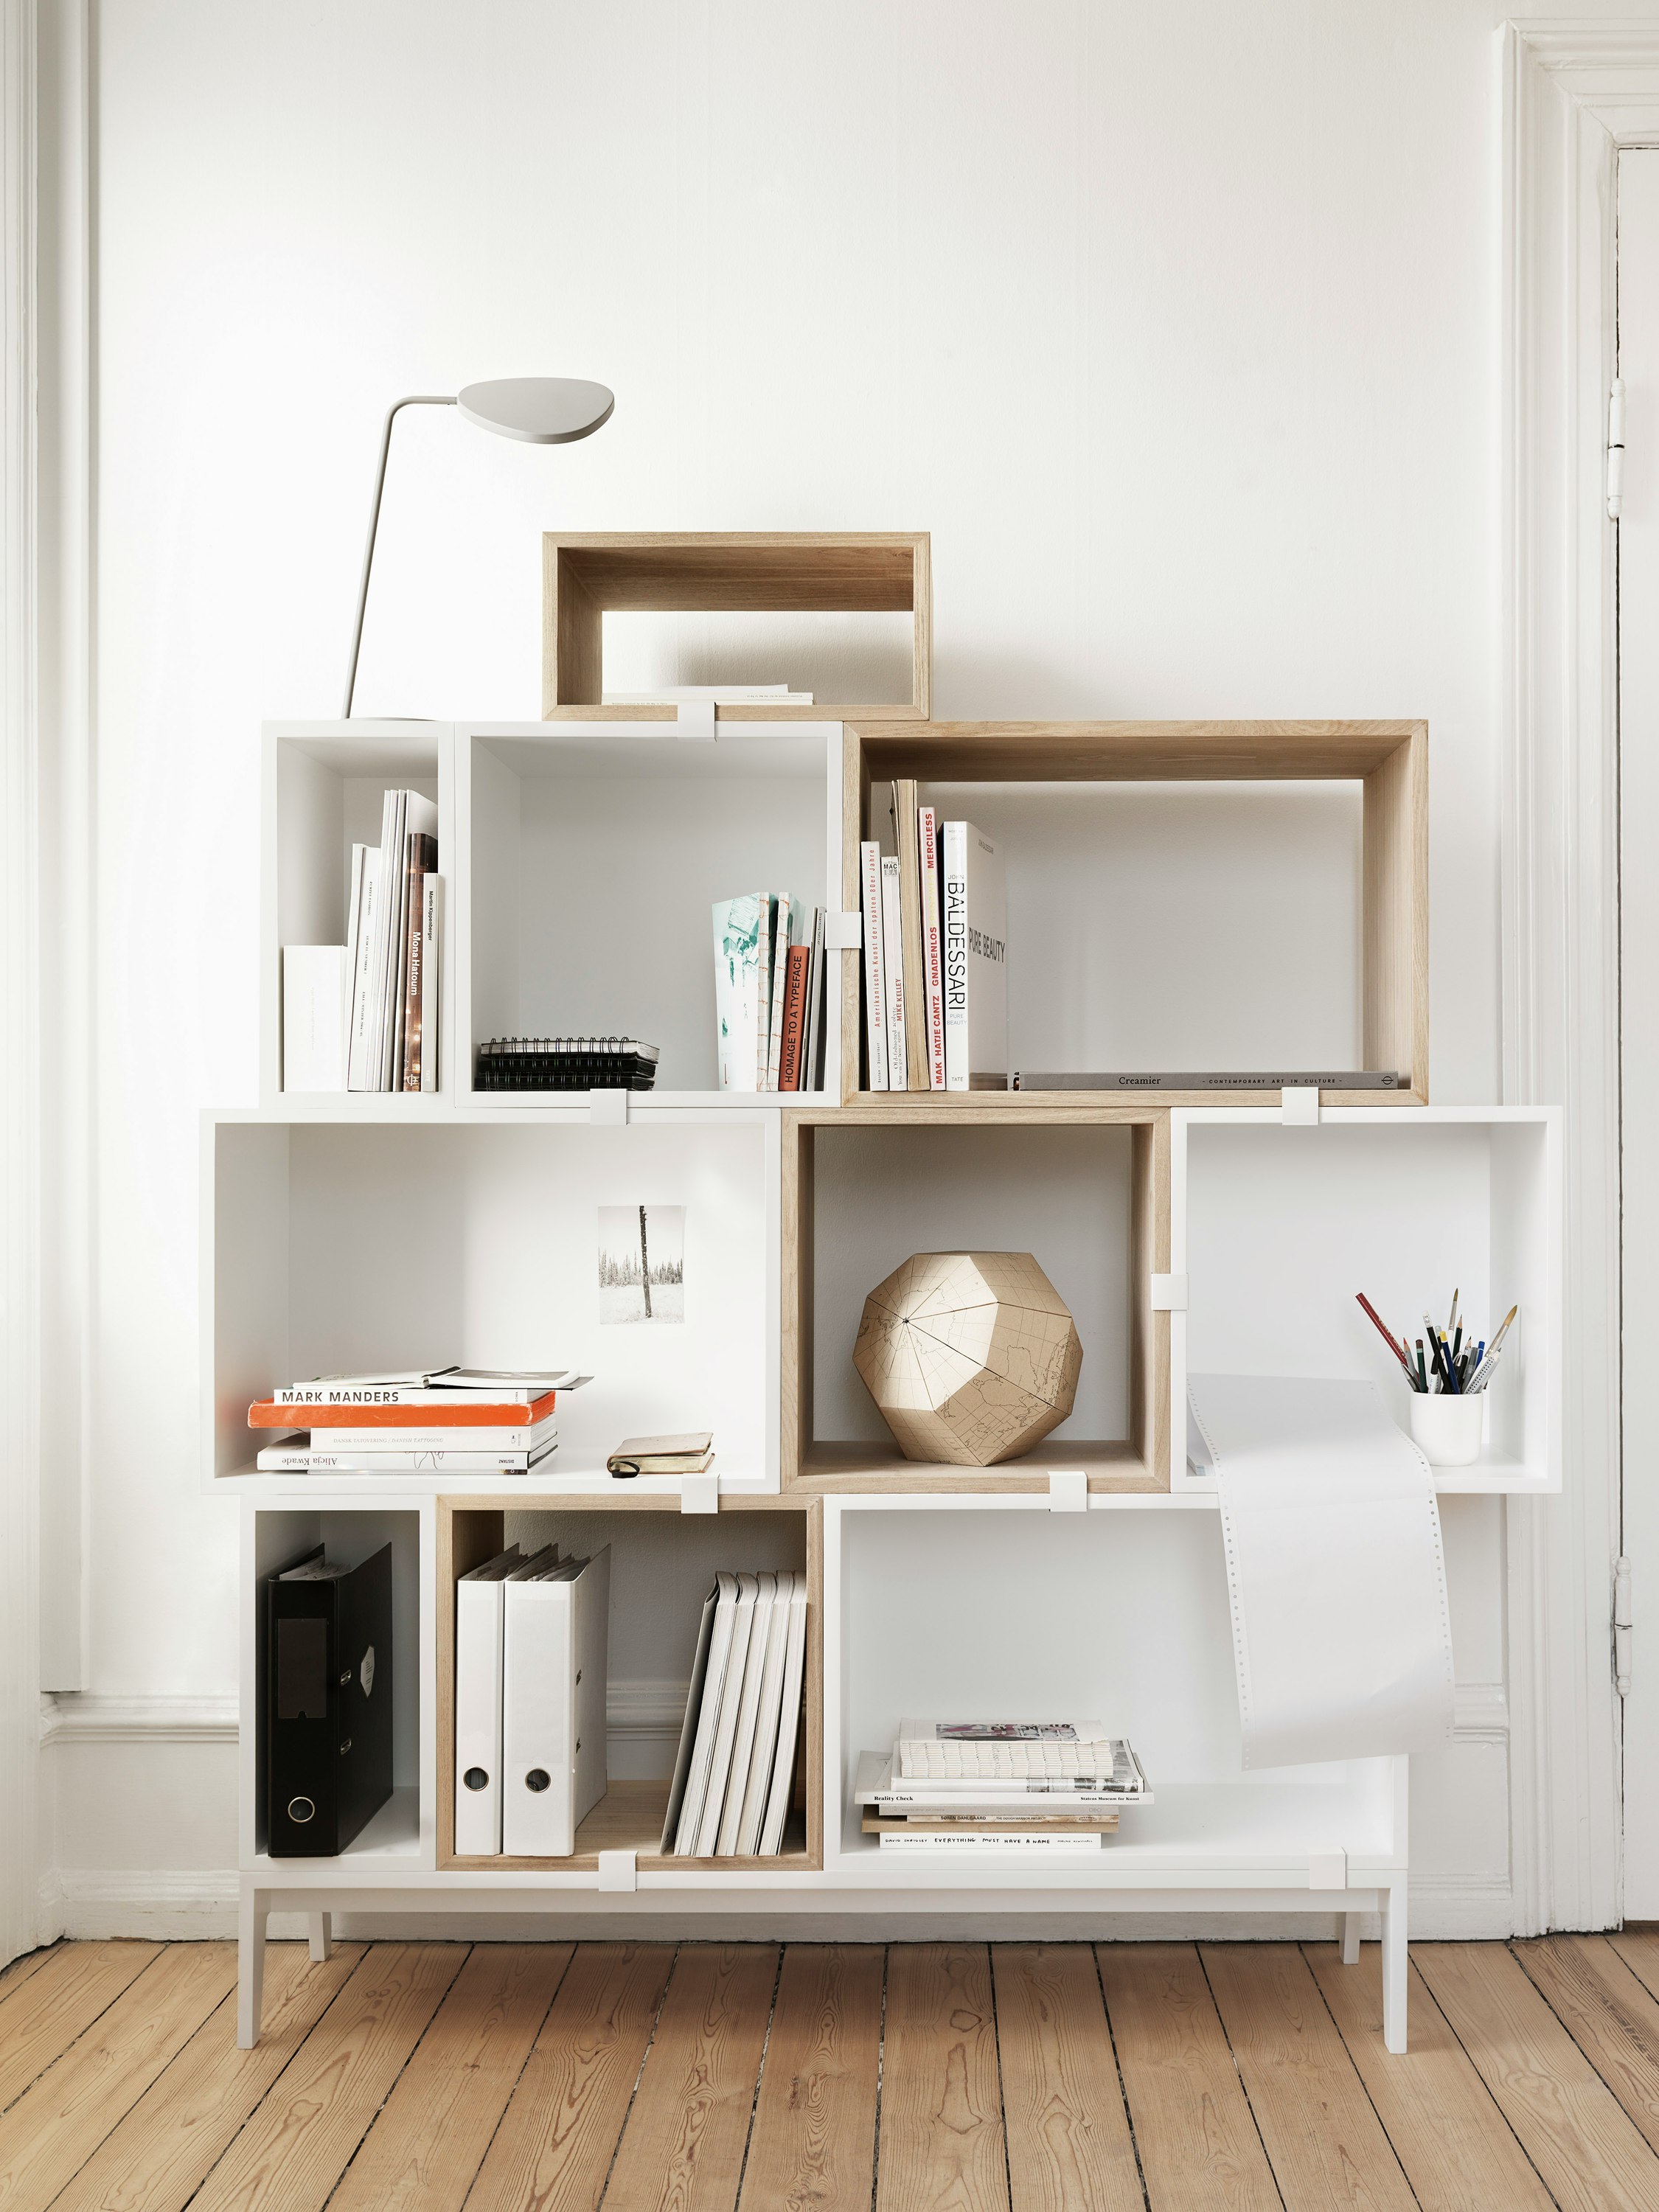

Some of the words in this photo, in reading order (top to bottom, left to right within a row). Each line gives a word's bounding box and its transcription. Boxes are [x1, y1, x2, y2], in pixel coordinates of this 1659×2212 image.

[925, 813, 934, 869] MERCILESS
[412, 931, 421, 958] Mona
[930, 927, 939, 986] GNADENLOS
[948, 883, 965, 1009] BALDESSARI
[969, 927, 981, 955] PURE
[983, 934, 1006, 963] BEAUTY
[411, 959, 420, 995] Hatoum
[790, 956, 802, 1010] TYPEFACE
[790, 1010, 799, 1019] A
[788, 1021, 798, 1036] TO
[933, 1029, 942, 1056] HATJE
[785, 1038, 796, 1083] HOMAGE
[1119, 1077, 1161, 1085] Creamier
[282, 1392, 323, 1402] MARK
[330, 1392, 399, 1402] MANDERS
[282, 1457, 310, 1466] Kwade
[313, 1457, 338, 1467] Alicja
